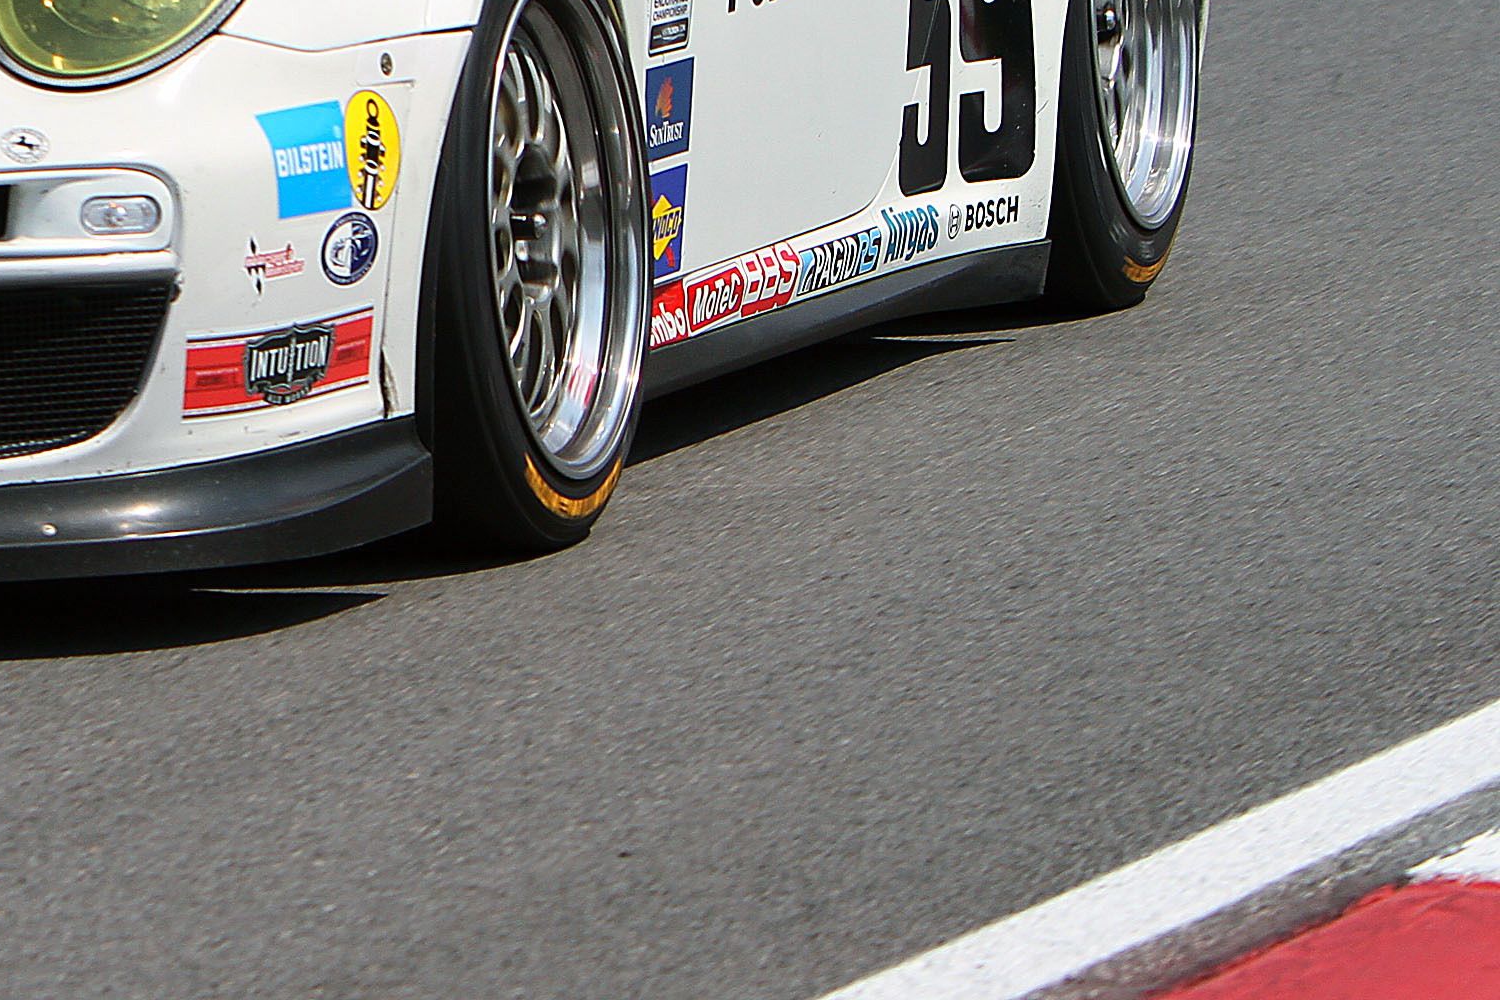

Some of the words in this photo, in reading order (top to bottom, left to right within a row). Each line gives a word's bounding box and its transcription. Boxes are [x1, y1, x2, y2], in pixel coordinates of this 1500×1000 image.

[275, 141, 344, 177] BILSTEIN
[653, 209, 680, 241] NOCO
[881, 205, 940, 264] Airgas
[964, 195, 1020, 232] BOSCH
[741, 241, 797, 303] BBS
[811, 235, 861, 290] PAGID
[692, 273, 741, 325] MoTeC
